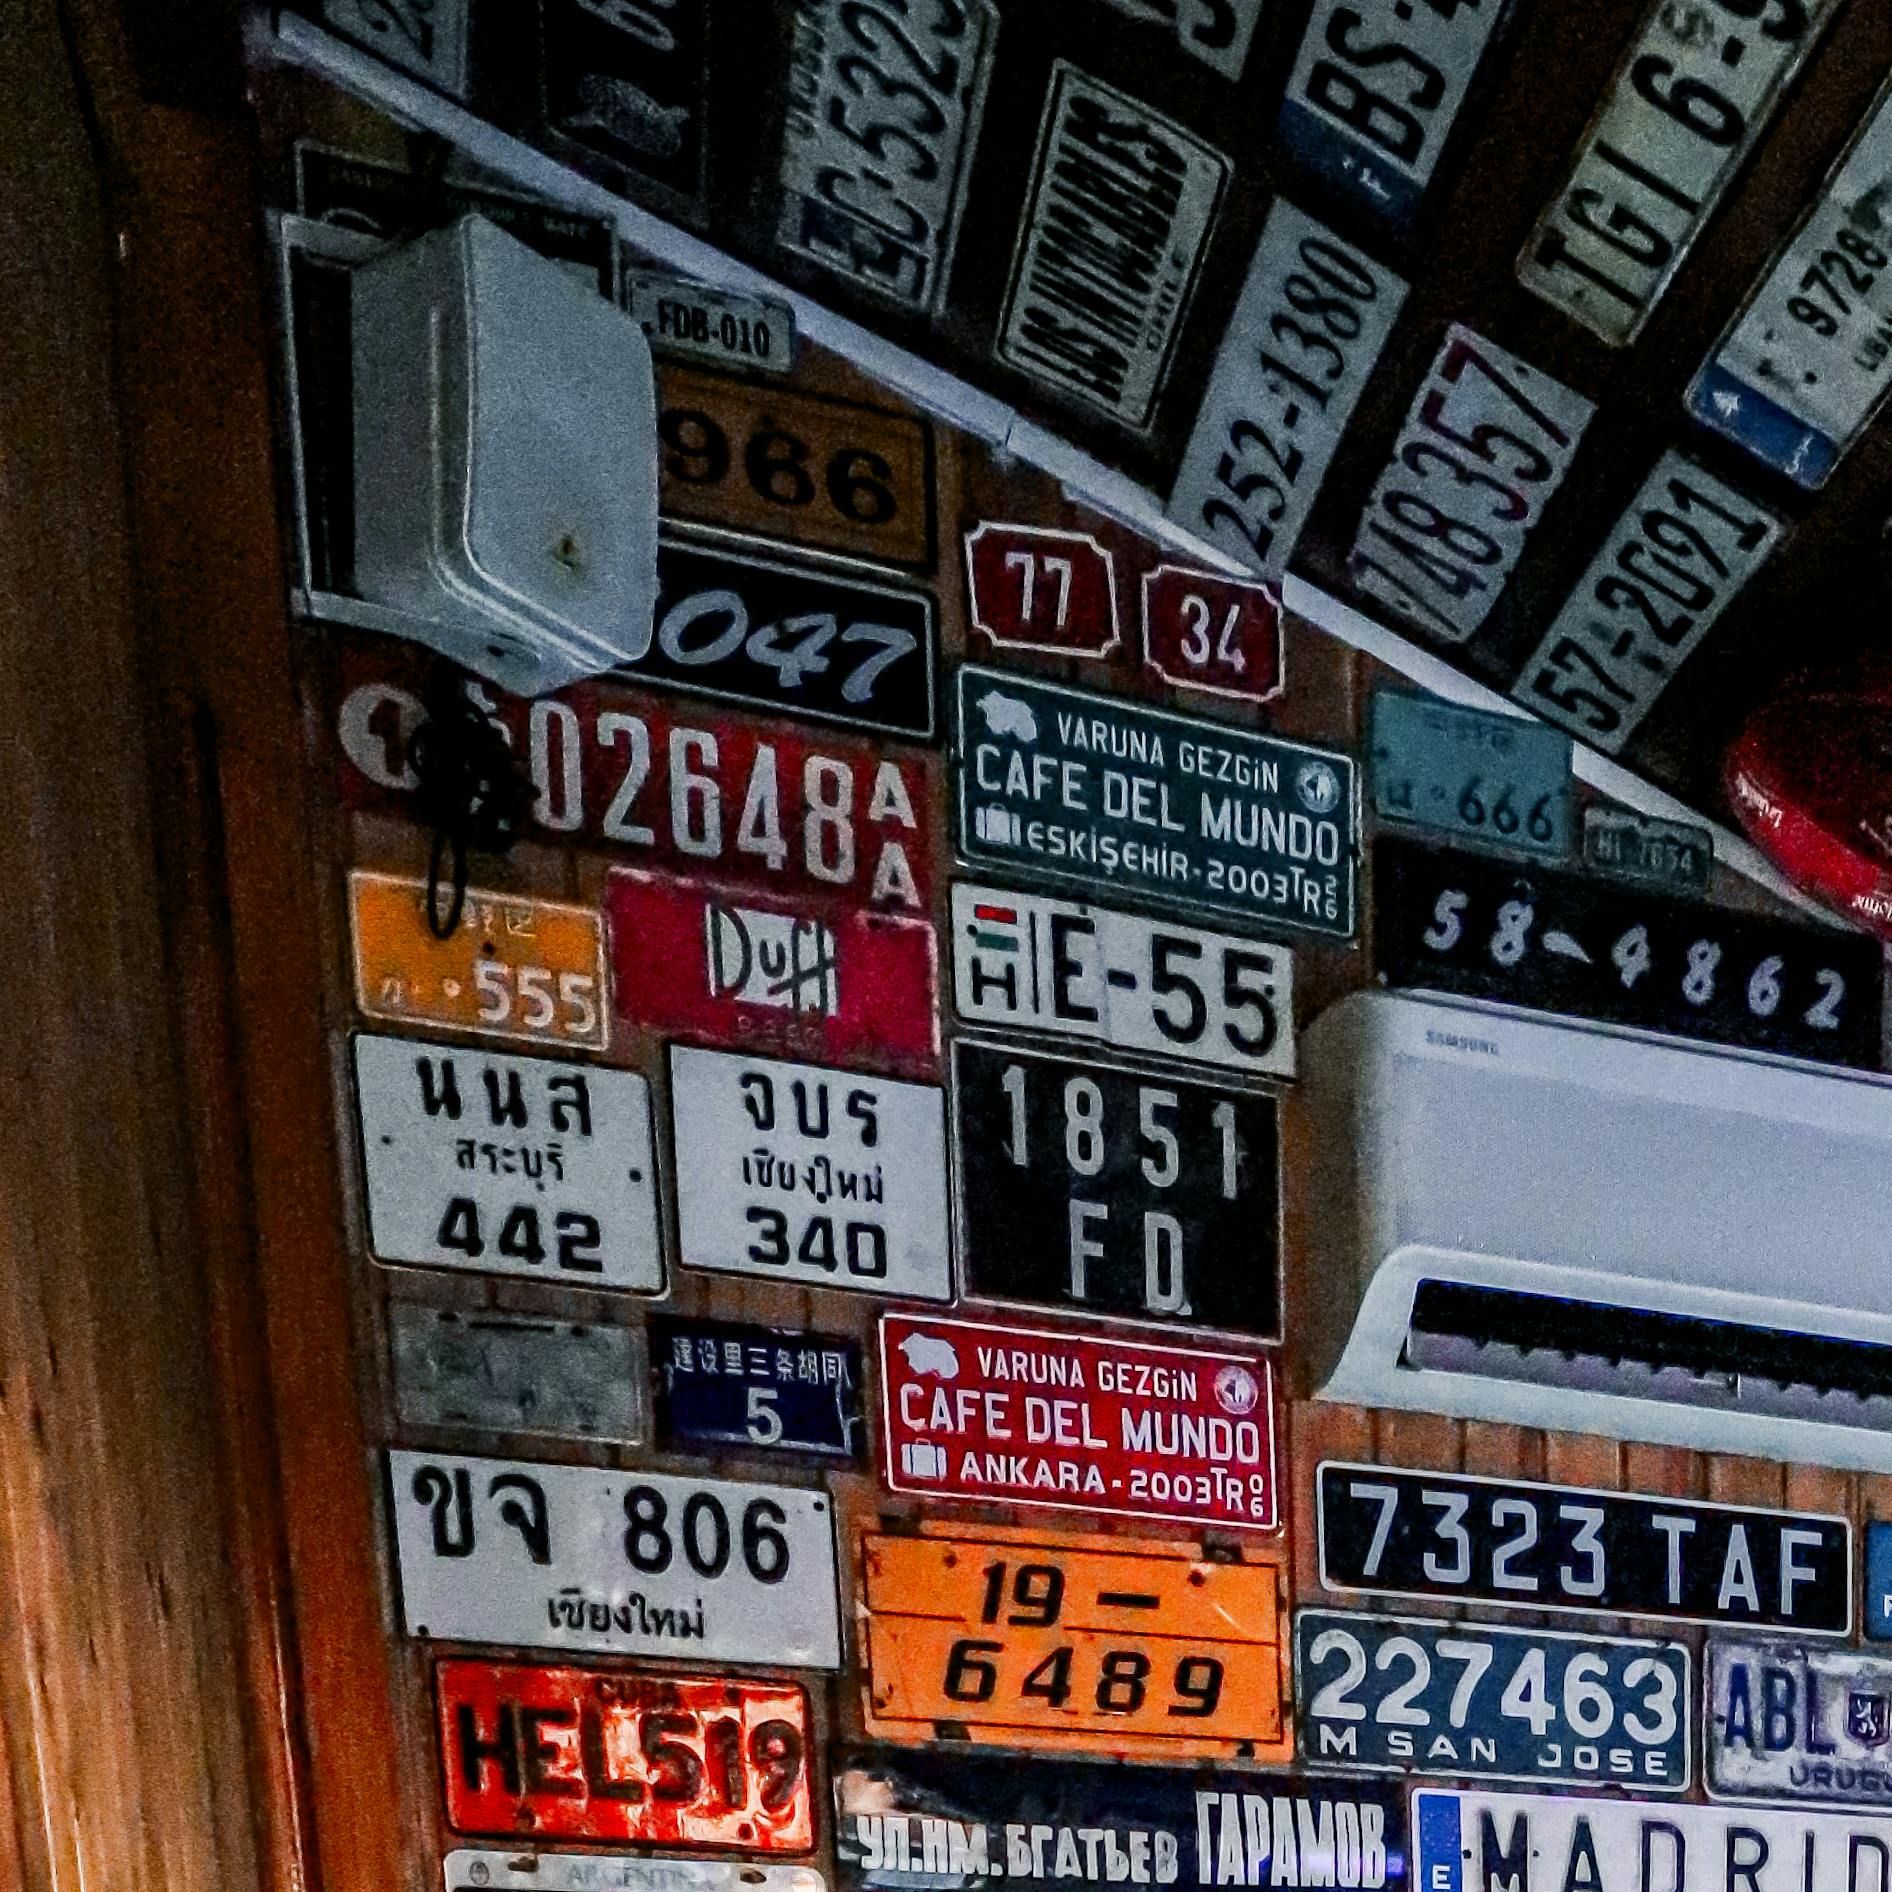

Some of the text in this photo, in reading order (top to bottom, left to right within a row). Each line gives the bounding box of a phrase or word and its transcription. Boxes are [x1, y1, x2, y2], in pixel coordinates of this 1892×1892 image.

[1020, 305, 1130, 402] LOS
[1205, 237, 1380, 562] 252-1380
[1005, 552, 1074, 630] 77
[1534, 478, 1770, 733] 57-2091
[1180, 596, 1247, 674] 34
[1057, 712, 1165, 769] VARUNA
[976, 742, 1339, 867] CAFE DEL MUNDO
[473, 960, 596, 1033] 555
[1050, 913, 1279, 1058] E-55
[1425, 1030, 1500, 1055] SAMSUNG
[1001, 1065, 1238, 1200] 1851
[437, 1198, 604, 1272] 442
[746, 1207, 887, 1278] 340
[977, 1346, 1086, 1388] VARUNA
[746, 1387, 783, 1445] 5
[900, 1384, 1260, 1464] CAFE DEL MUNDO
[959, 1451, 1106, 1496] ANKARA
[622, 1485, 791, 1585] 806
[1349, 1482, 1824, 1616] 7323 TAF
[981, 1561, 1067, 1628] 19
[942, 1638, 1225, 1717] 6489
[1309, 1628, 1678, 1746] 227463
[1722, 1662, 1836, 1756] ABL
[1319, 1725, 1669, 1777] M SAN JOSE
[1432, 1866, 1452, 1890] E
